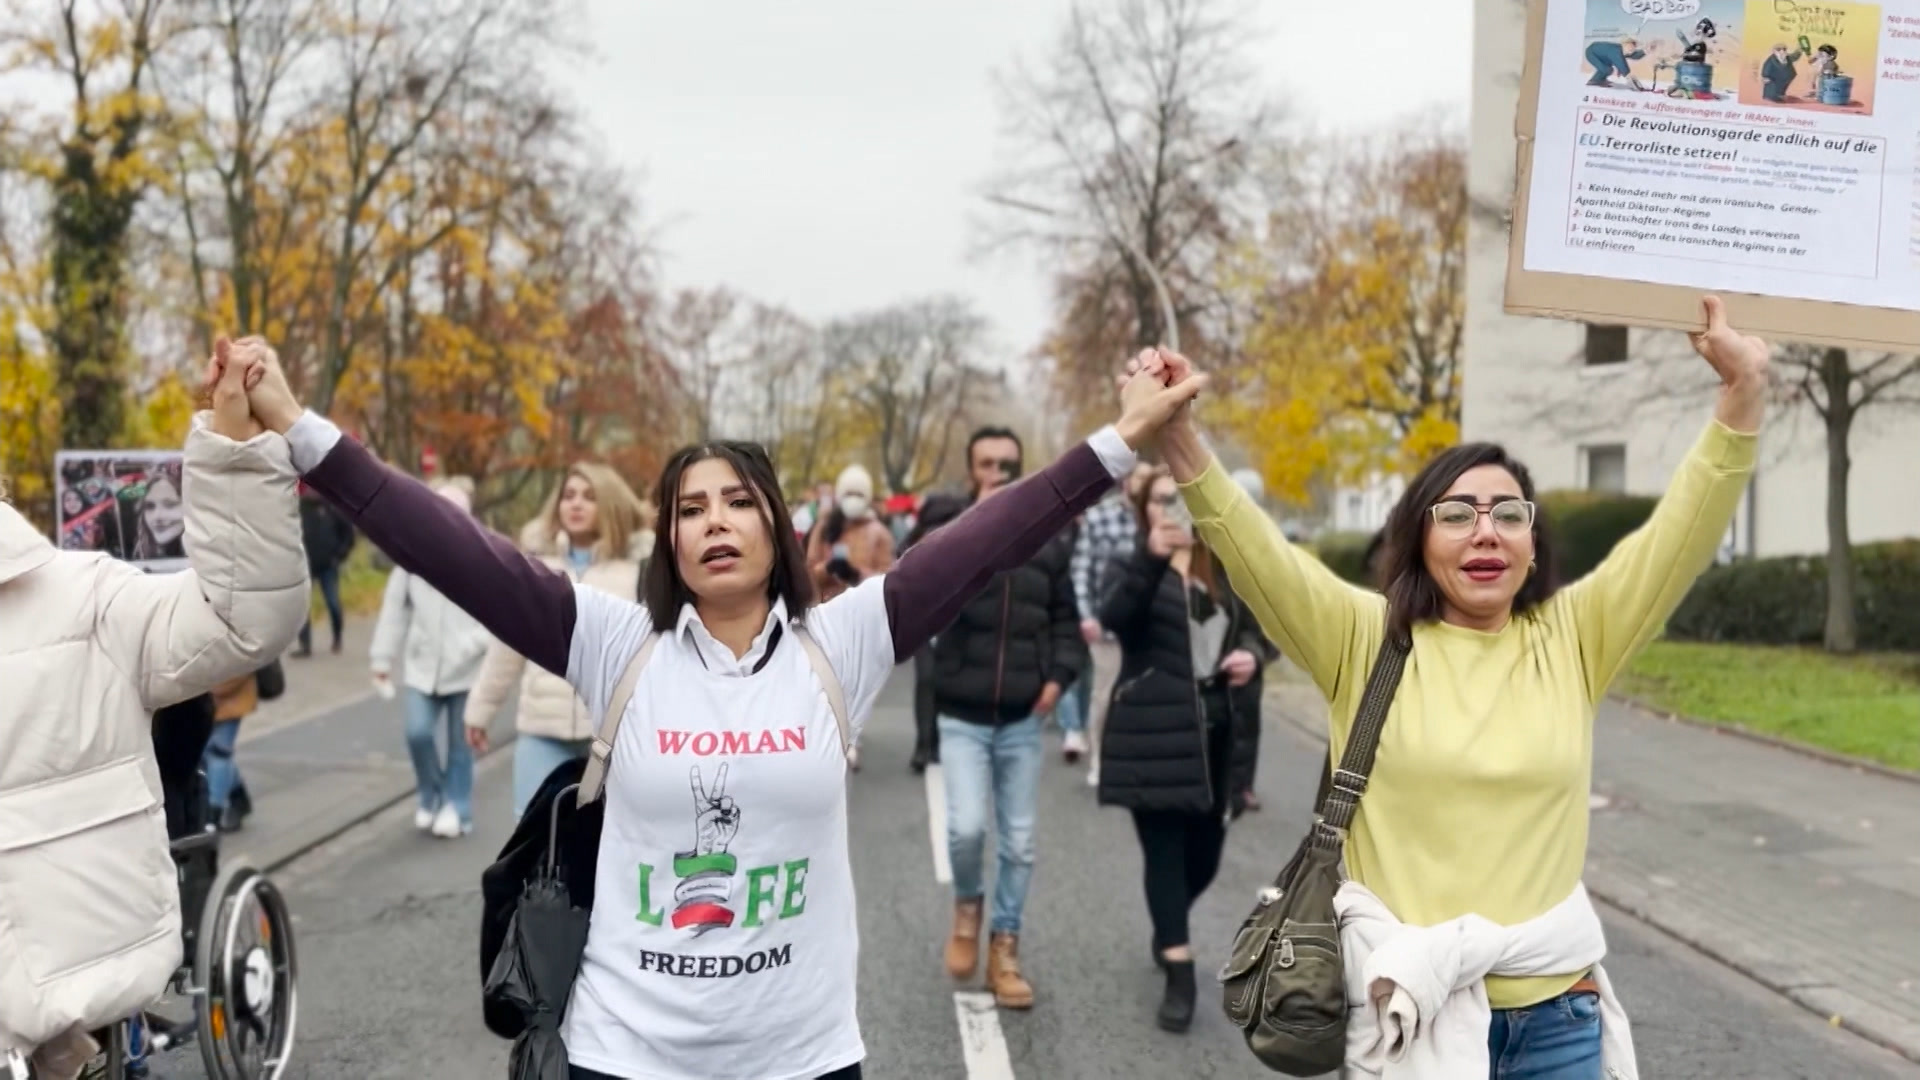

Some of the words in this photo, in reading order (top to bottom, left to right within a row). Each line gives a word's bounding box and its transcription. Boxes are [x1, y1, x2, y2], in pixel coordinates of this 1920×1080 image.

[1592, 95, 1637, 108] konkrete
[1643, 102, 1722, 119] Aufforderungen
[1725, 110, 1742, 119] der
[1602, 113, 1626, 128] Die
[1630, 117, 1762, 143] Revolutionsgarde
[1766, 132, 1820, 148] endlich
[1824, 138, 1852, 154] auf
[1854, 139, 1878, 154] die
[1684, 146, 1738, 161] setzen!
[1575, 195, 1626, 209] Apartheid
[1589, 183, 1611, 194] Kein
[1613, 185, 1649, 198] Handel
[1651, 190, 1677, 200] mehr
[1680, 193, 1697, 202] mit
[1698, 195, 1722, 205] dem
[1724, 197, 1775, 210] iranischen
[1585, 209, 1601, 219] Die
[1604, 211, 1662, 226] Botschafter
[1692, 222, 1709, 231] des
[1712, 223, 1747, 236] Landes
[1749, 228, 1800, 240] verweisen
[1569, 237, 1584, 246] EU
[1585, 239, 1635, 252] einfrieren
[1583, 223, 1602, 234] Das
[1605, 226, 1657, 240] Vermögen
[1659, 233, 1676, 242] des
[1678, 236, 1730, 248] iranischen
[1732, 240, 1775, 252] Regimes
[1777, 245, 1787, 254] in
[1789, 246, 1807, 256] der
[657, 725, 807, 756] WOMAN
[638, 943, 792, 978] FREEDOM
